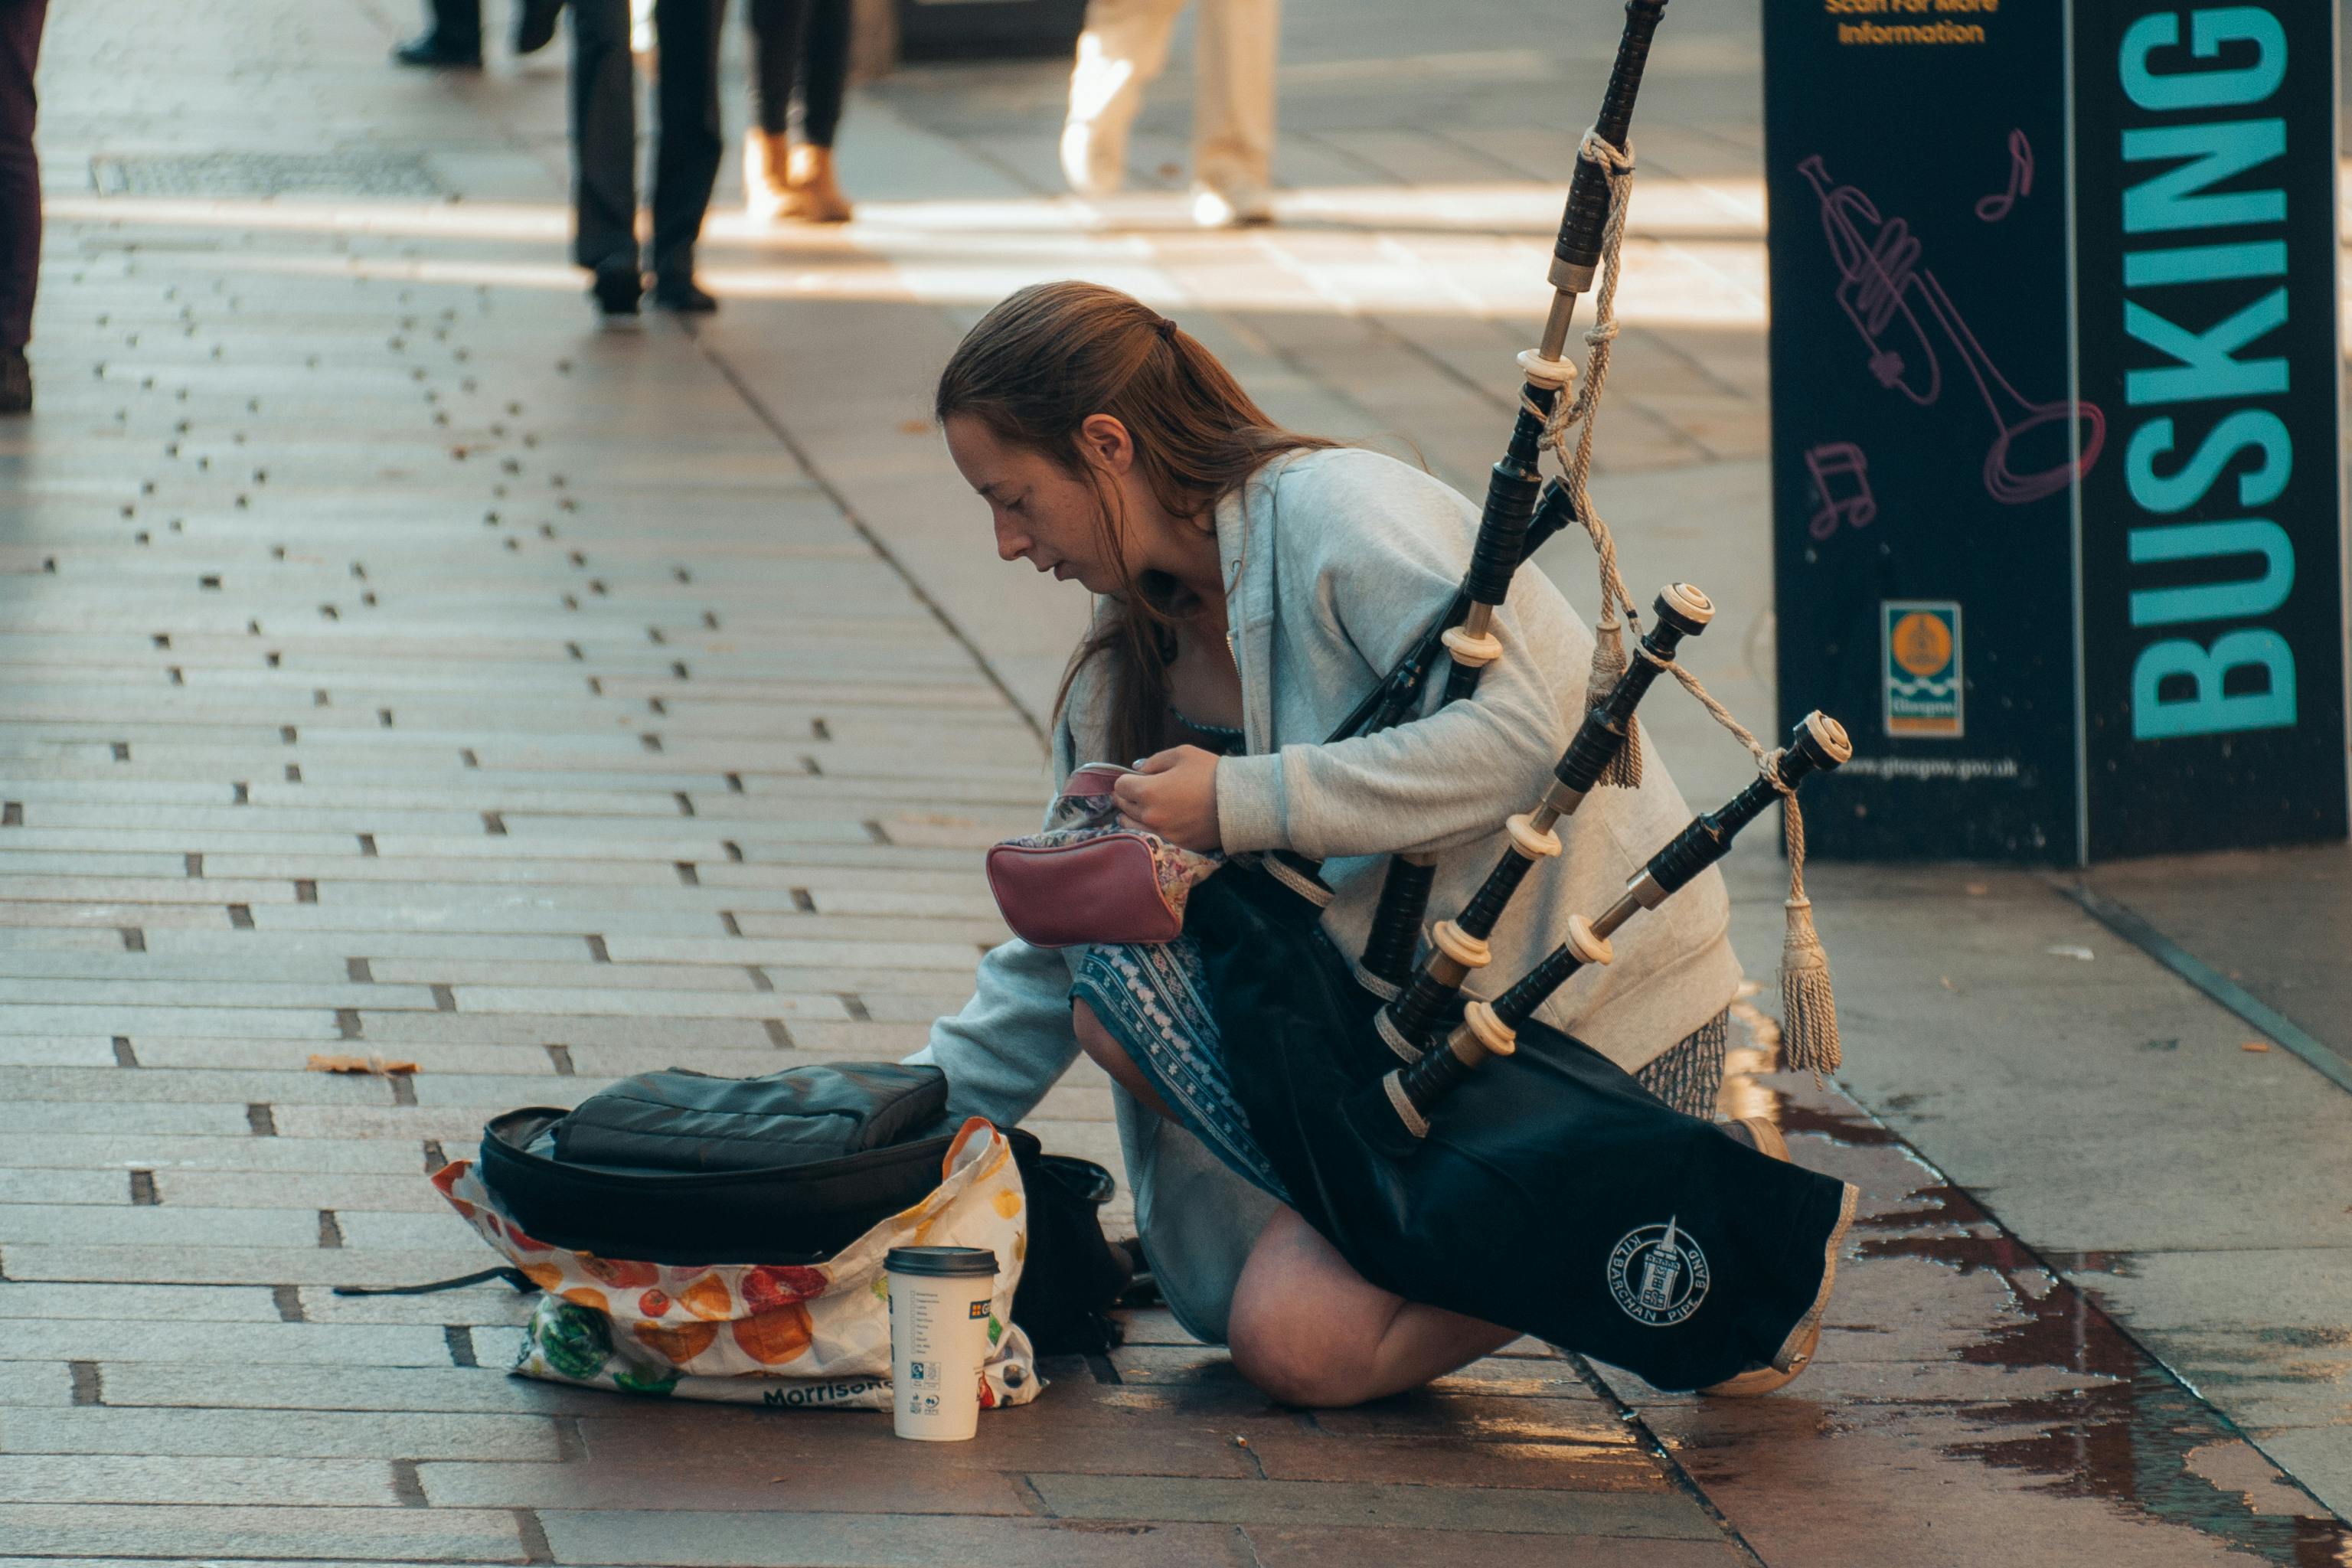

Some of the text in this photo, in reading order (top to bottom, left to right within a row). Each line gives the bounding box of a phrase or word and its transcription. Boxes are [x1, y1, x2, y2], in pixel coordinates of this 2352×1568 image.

[1838, 20, 1984, 44] Information
[2118, 5, 2297, 740] BUSKING
[1611, 1235, 1707, 1321] KILBARCHAN PIPE BAND
